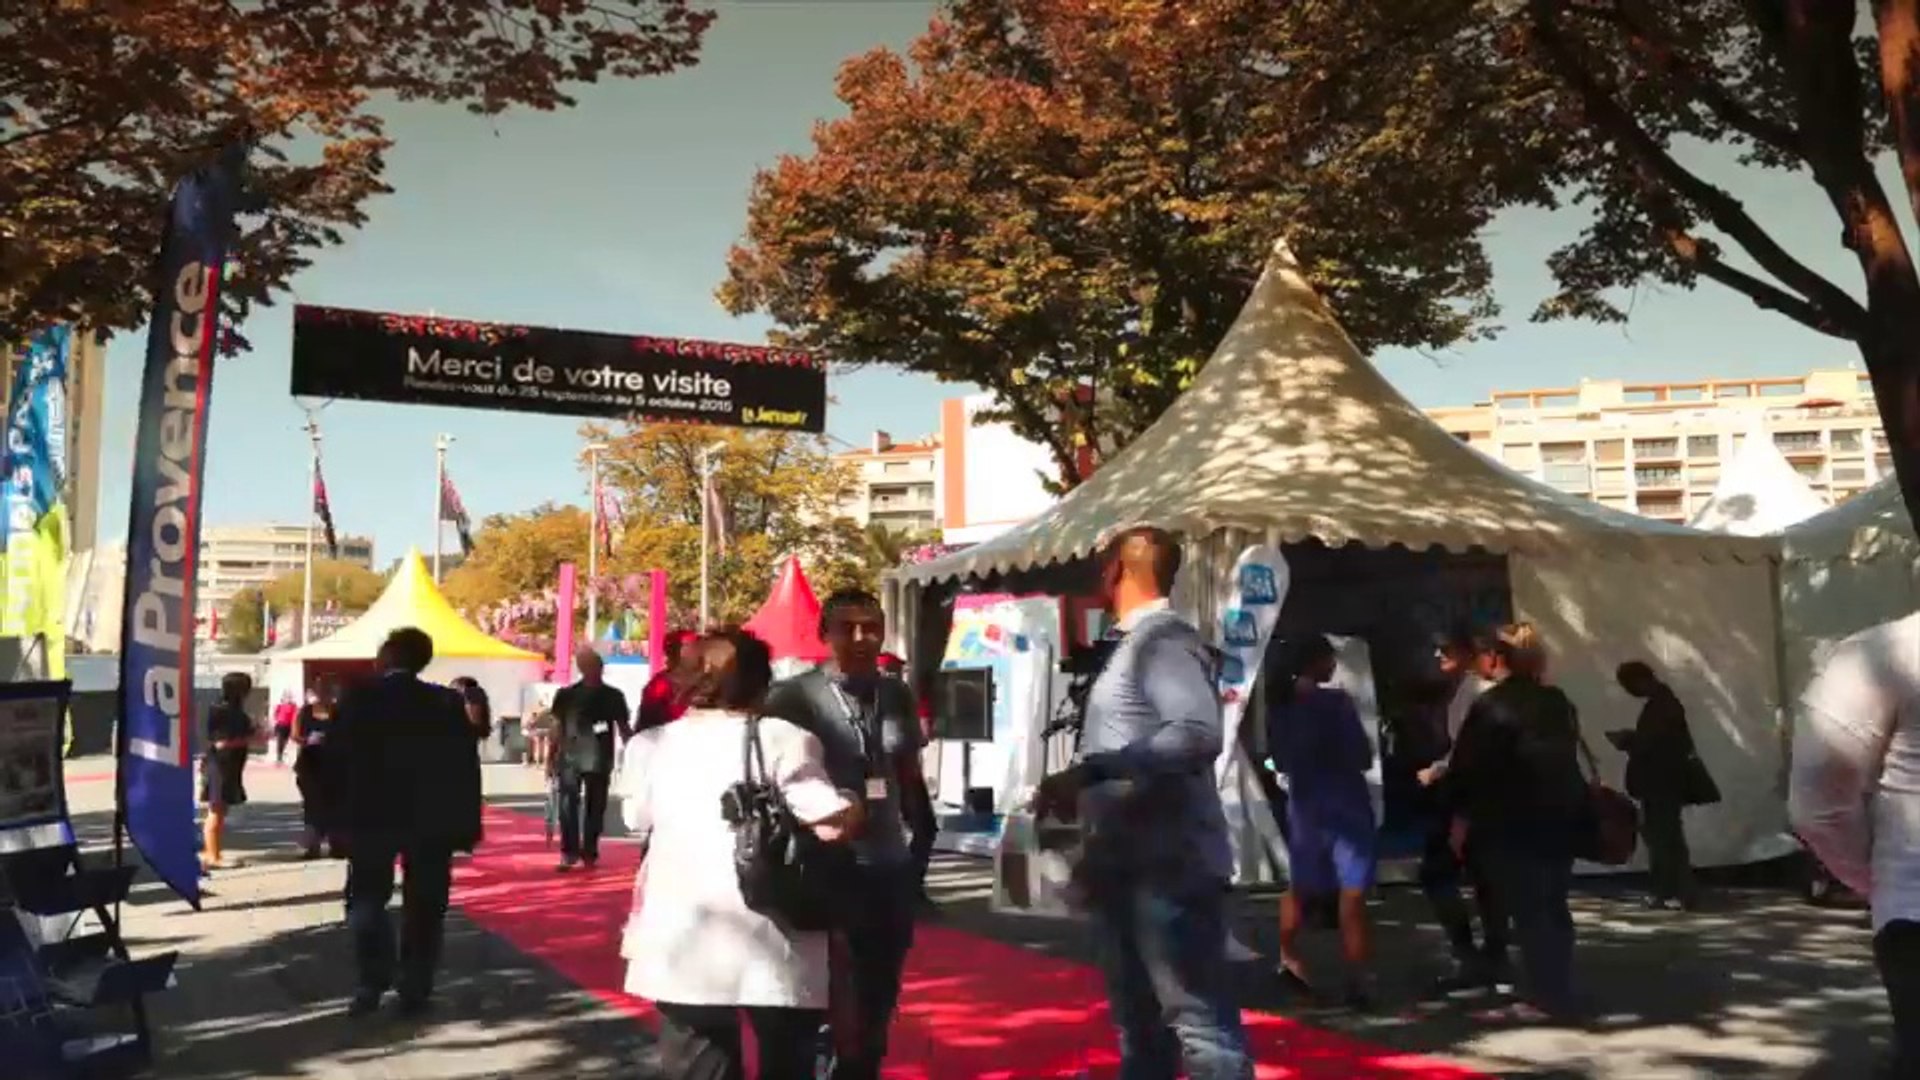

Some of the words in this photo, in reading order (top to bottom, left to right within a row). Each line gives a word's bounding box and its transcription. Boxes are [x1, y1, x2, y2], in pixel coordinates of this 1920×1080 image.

[407, 346, 503, 381] Merci
[512, 356, 555, 384] de
[563, 364, 645, 391] votre
[652, 369, 732, 397] visite
[615, 395, 632, 406] au
[634, 393, 646, 407] 5
[648, 396, 696, 410] octobre
[698, 400, 733, 413] 2015
[132, 261, 211, 651] Provence
[129, 660, 181, 767] La
